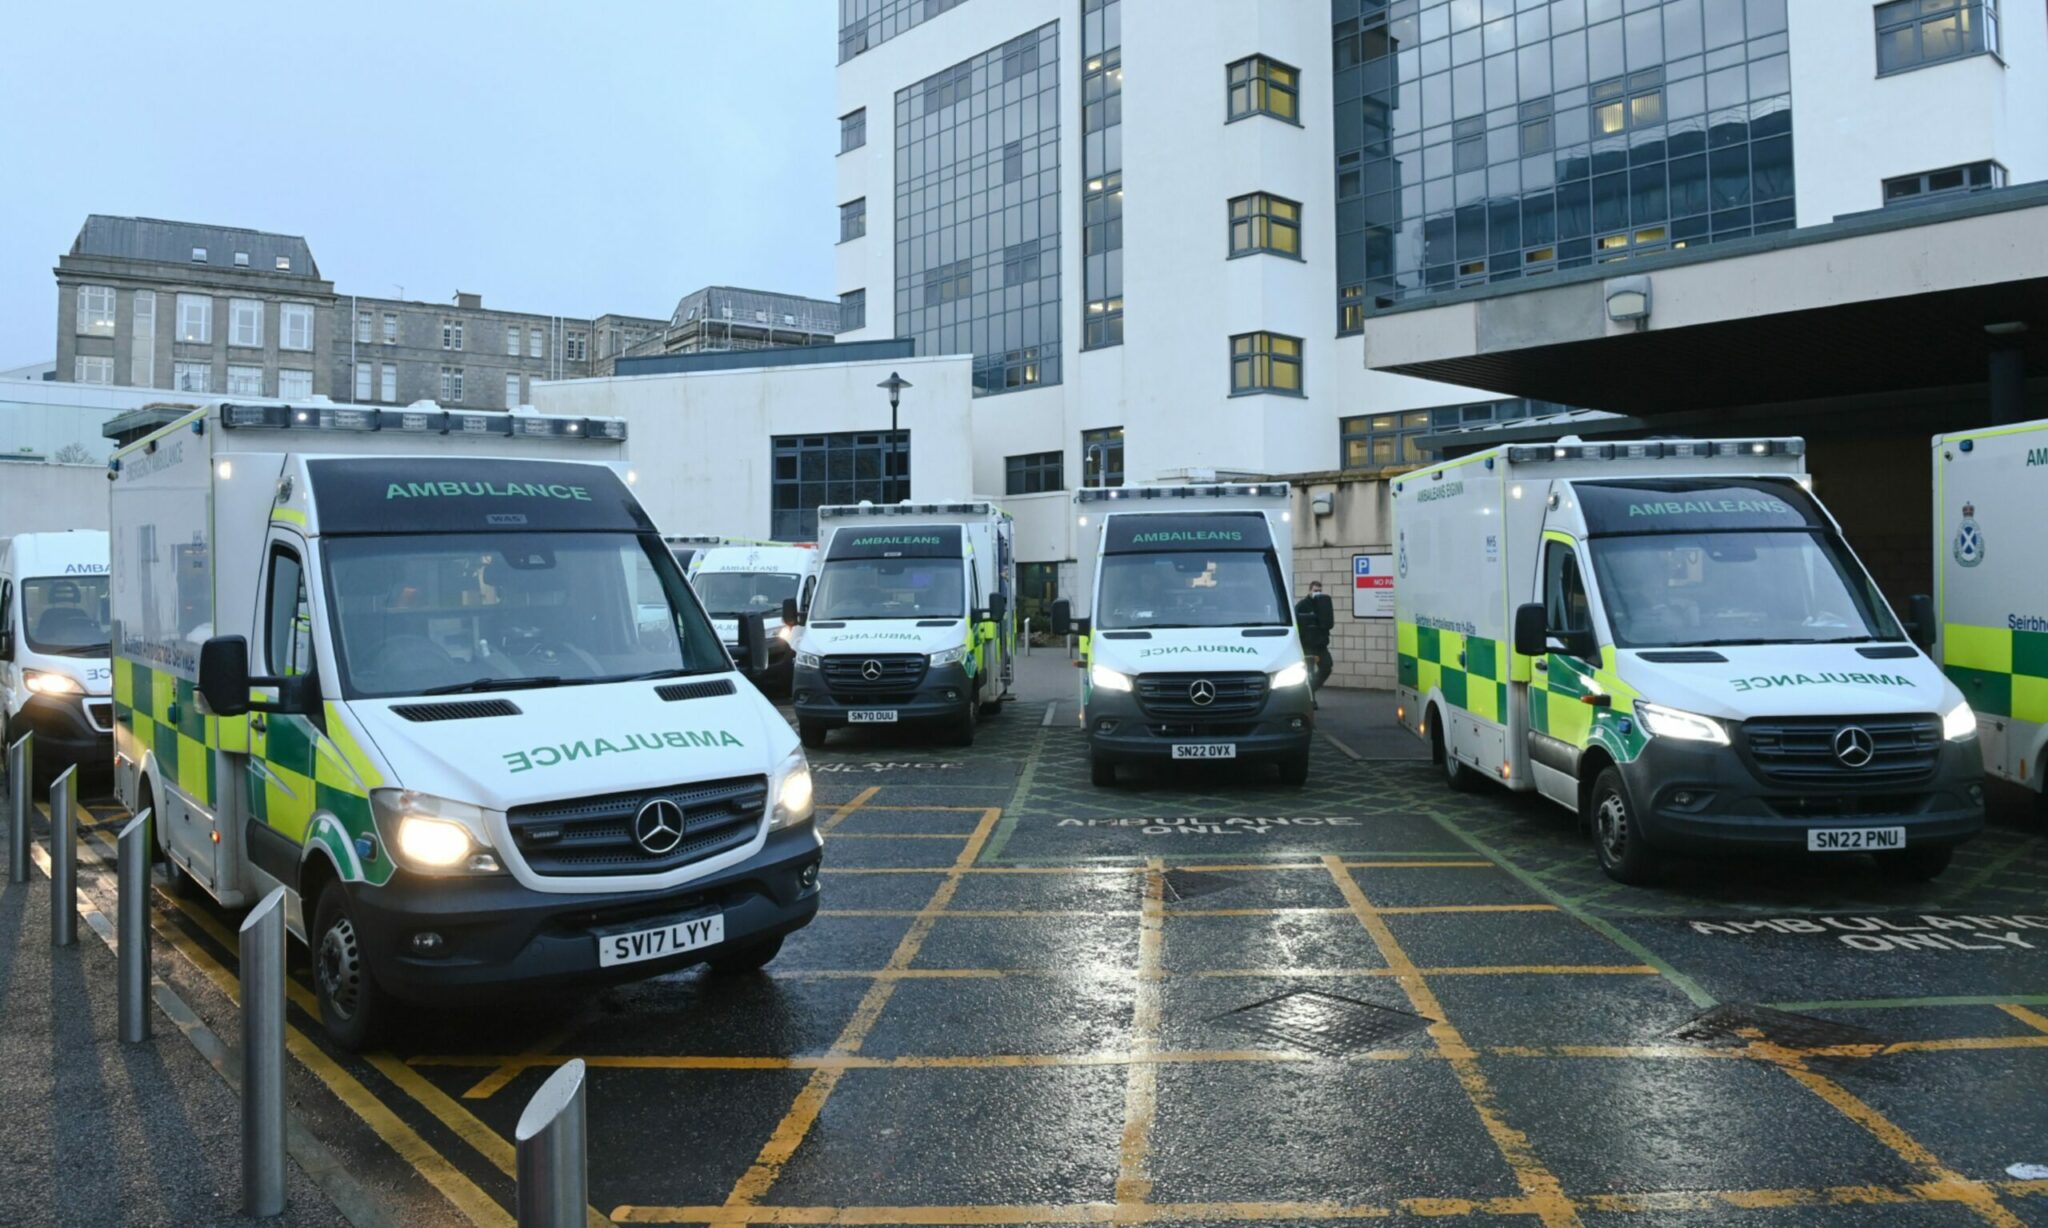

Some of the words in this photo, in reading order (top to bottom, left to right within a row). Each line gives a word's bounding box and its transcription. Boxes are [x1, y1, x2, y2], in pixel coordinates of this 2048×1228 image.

[386, 481, 593, 501] AMBULANCE
[1628, 500, 1788, 517] AMBAILEANS
[852, 536, 941, 546] AMBAILEANS
[1132, 531, 1243, 544] AMBAILEANS
[2008, 613, 2048, 632] Seirbh
[851, 712, 874, 721] SN70
[1177, 745, 1206, 757] SN22
[1056, 817, 1363, 827] AMBULANCE
[1142, 825, 1274, 835] ONLY
[1816, 831, 1862, 848] SN22
[1866, 829, 1898, 847] PNU
[614, 930, 666, 960] SV17
[672, 919, 712, 949] LYY
[1838, 932, 2036, 951] ONLY
